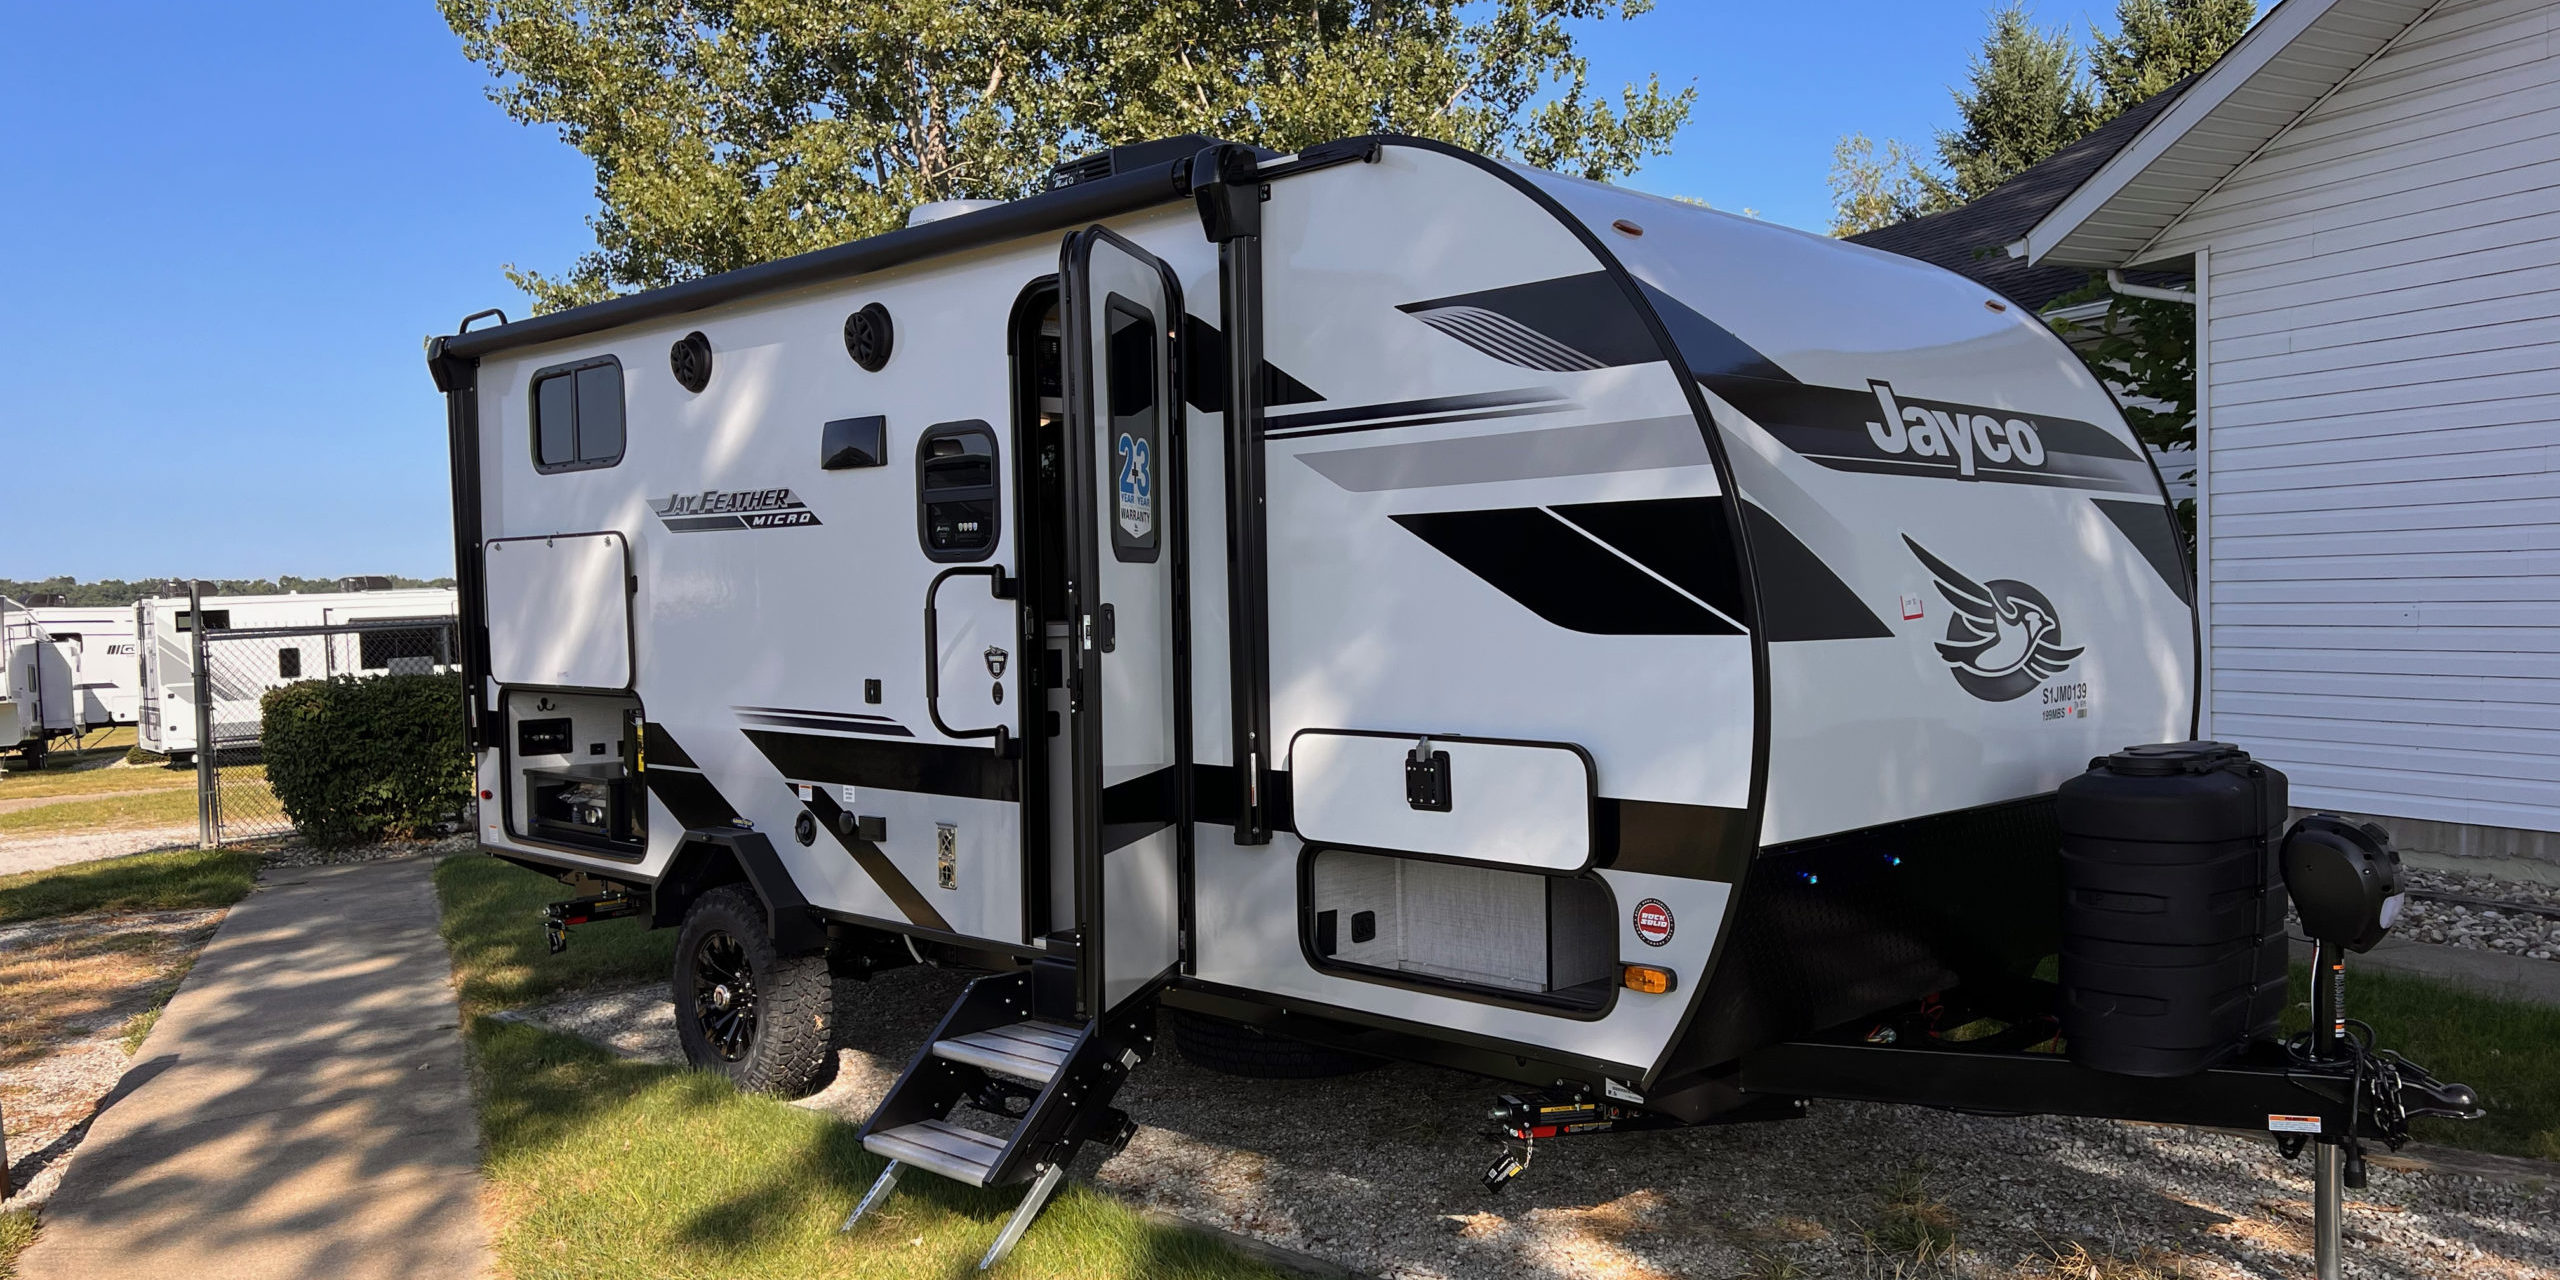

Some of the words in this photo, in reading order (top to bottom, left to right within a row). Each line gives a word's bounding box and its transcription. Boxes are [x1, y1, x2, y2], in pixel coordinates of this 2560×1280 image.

[1866, 384, 2044, 476] Jayco
[1121, 493, 1135, 505] YEAR
[1137, 496, 1150, 507] YEAR
[752, 513, 811, 526] MICRO
[1121, 507, 1150, 523] WARRANTY
[2042, 682, 2087, 705] S1JM0139
[1640, 918, 1668, 928] SOLID
[1641, 912, 1666, 921] ROCK
